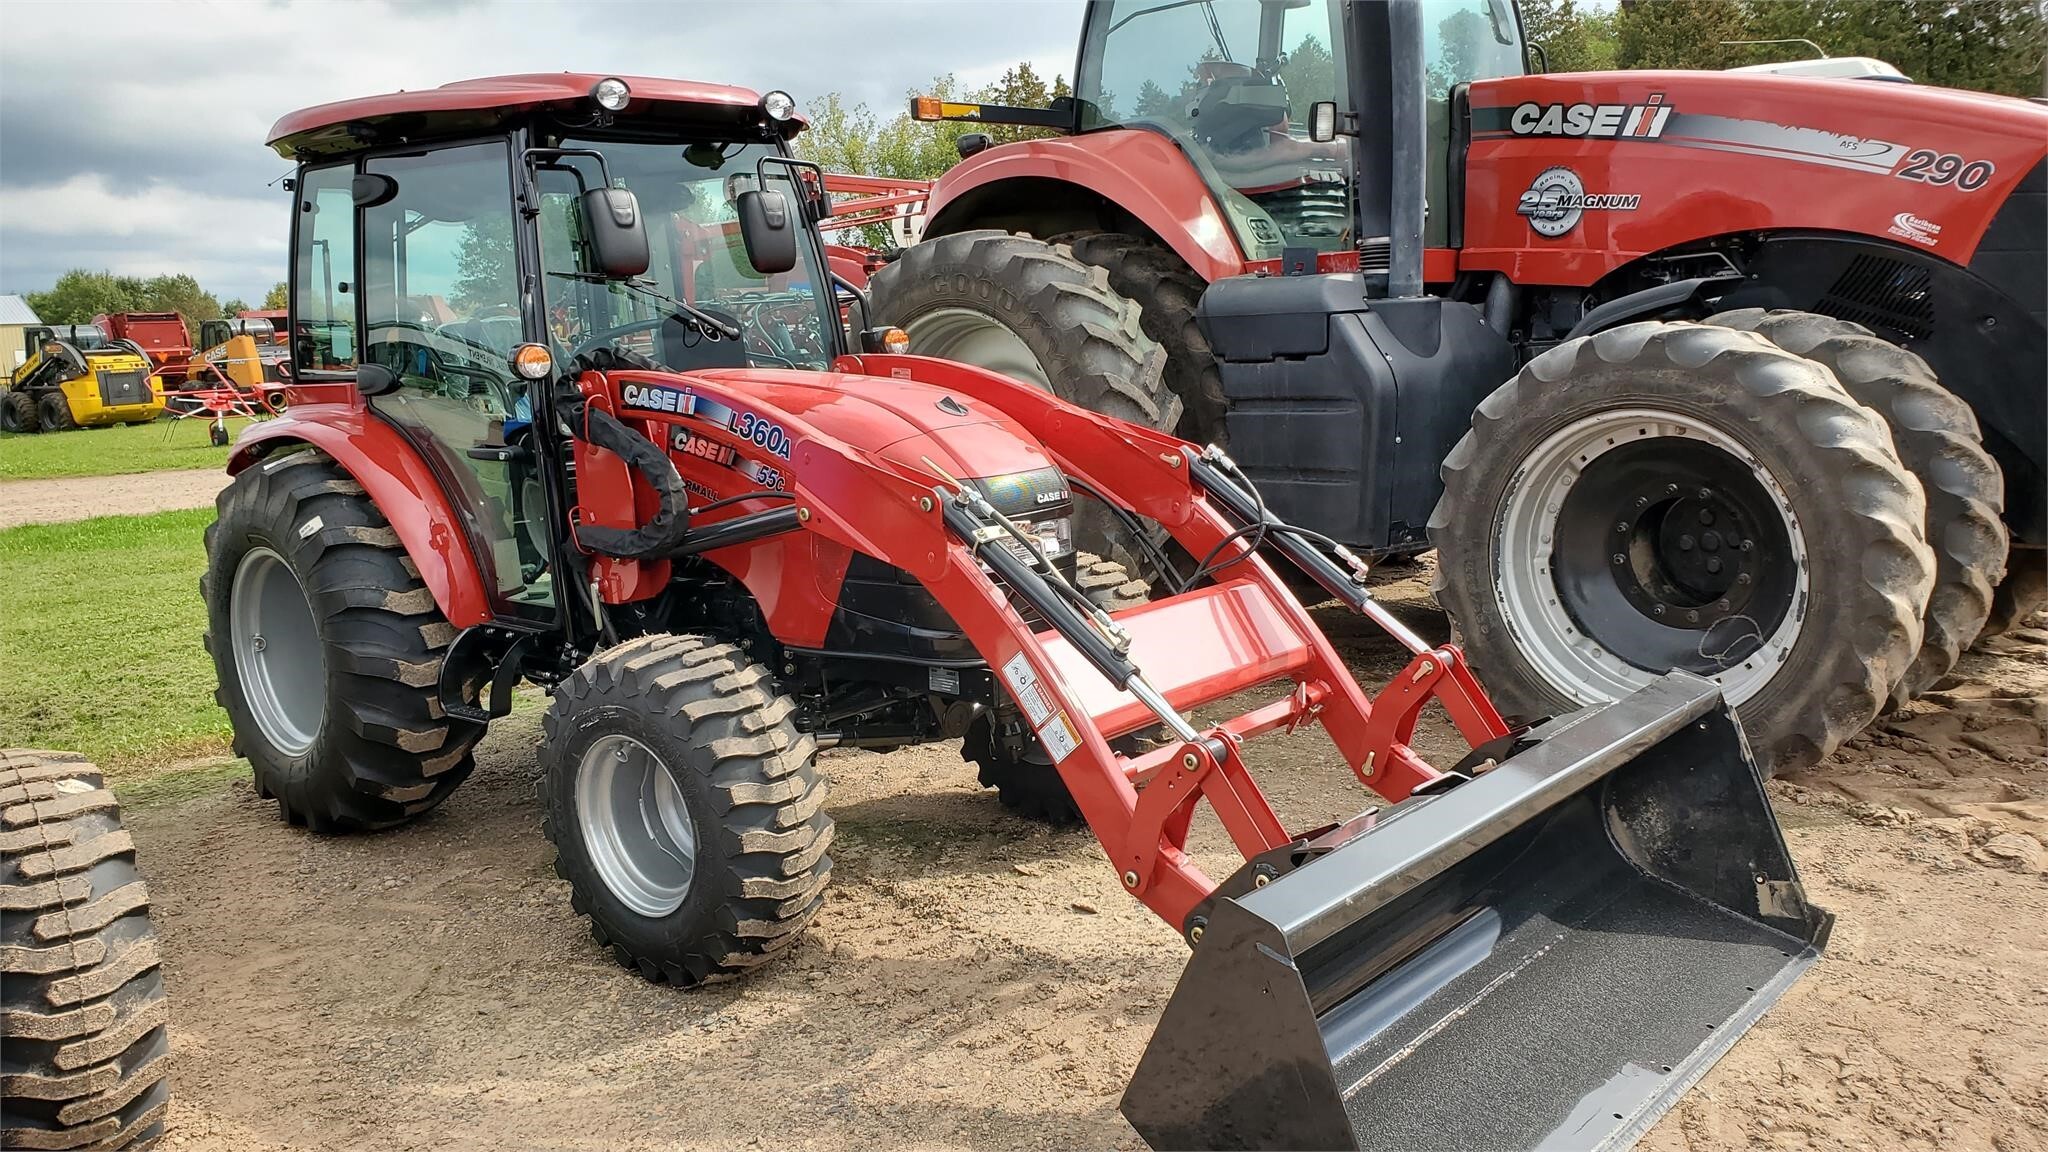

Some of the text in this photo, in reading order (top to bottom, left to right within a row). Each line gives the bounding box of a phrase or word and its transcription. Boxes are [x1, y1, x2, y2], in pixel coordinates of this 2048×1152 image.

[1510, 102, 1626, 137] CASE
[1839, 140, 1859, 151] AFS
[1895, 149, 1996, 193] 290
[1517, 190, 1562, 215] 25
[1556, 194, 1641, 210] MAGNUM
[1532, 209, 1565, 220] years
[205, 345, 227, 363] CASE
[623, 384, 677, 412] CASE
[674, 432, 719, 461] CASE
[727, 411, 793, 462] L360A
[683, 479, 720, 503] RMALL
[1036, 491, 1061, 504] CASE
